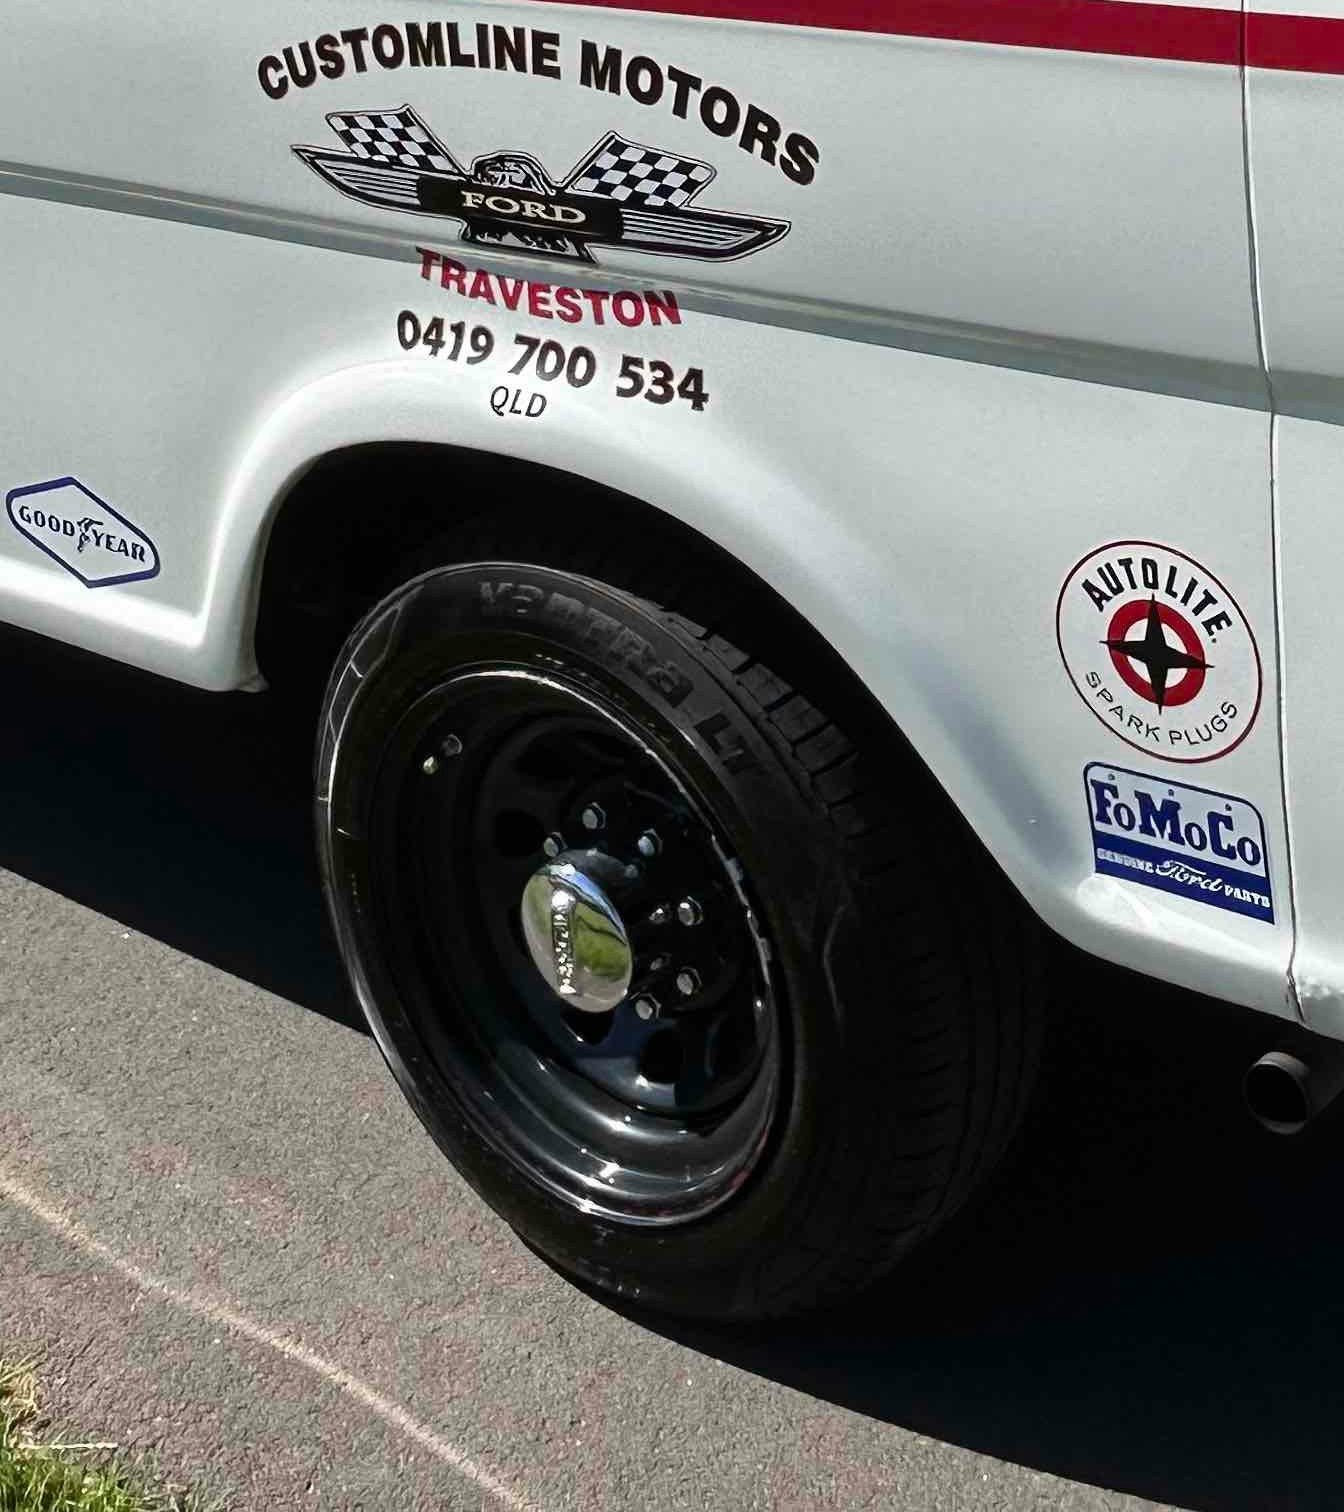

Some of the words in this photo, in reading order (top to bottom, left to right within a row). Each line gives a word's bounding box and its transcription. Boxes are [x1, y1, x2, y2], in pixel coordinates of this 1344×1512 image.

[258, 21, 562, 100] CUSTOMLINE
[579, 39, 821, 186] MOTORS
[460, 188, 587, 225] FORD
[415, 246, 683, 327] TRAVESTON
[396, 309, 495, 366] 0419
[510, 333, 597, 388] 700
[615, 354, 710, 411] 534
[489, 385, 548, 420] QLD
[1081, 557, 1233, 641] AUTOLITE
[1086, 670, 1161, 743] SPARK
[1168, 700, 1239, 746] PLUGS
[1090, 778, 1262, 867] FoMoCo
[1156, 859, 1223, 892] Ford
